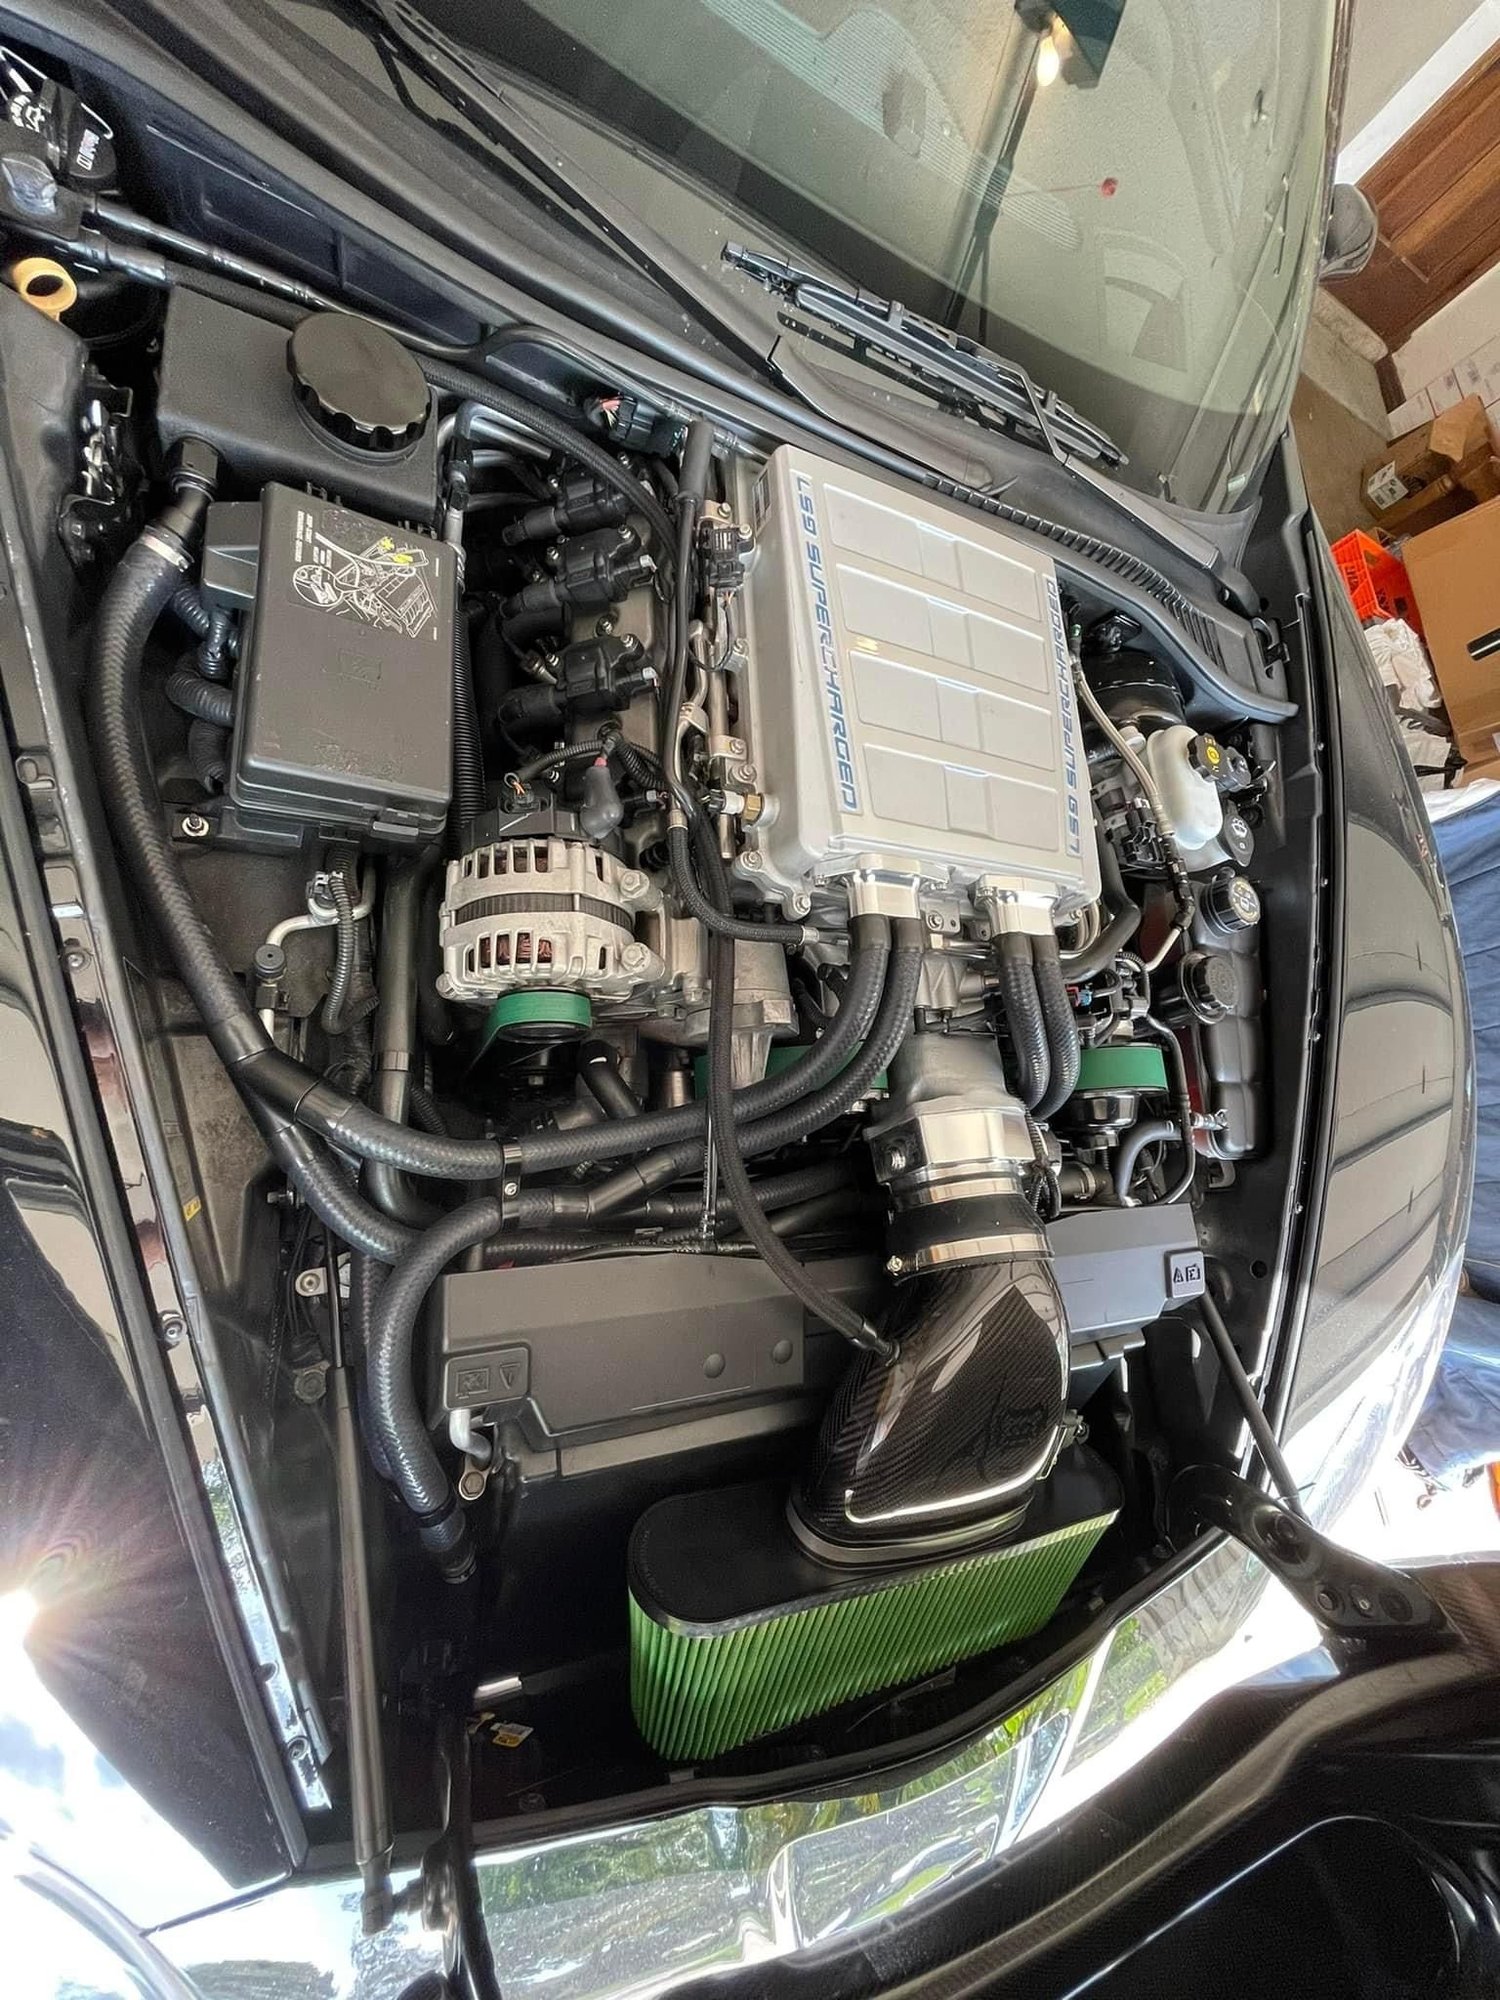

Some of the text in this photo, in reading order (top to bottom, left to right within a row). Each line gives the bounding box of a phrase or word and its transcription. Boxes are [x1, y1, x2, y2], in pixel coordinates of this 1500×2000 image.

[797, 476, 858, 809] LS9 SUPERCHARGED
[1046, 578, 1080, 854] LS9 SUPERCHARGED
